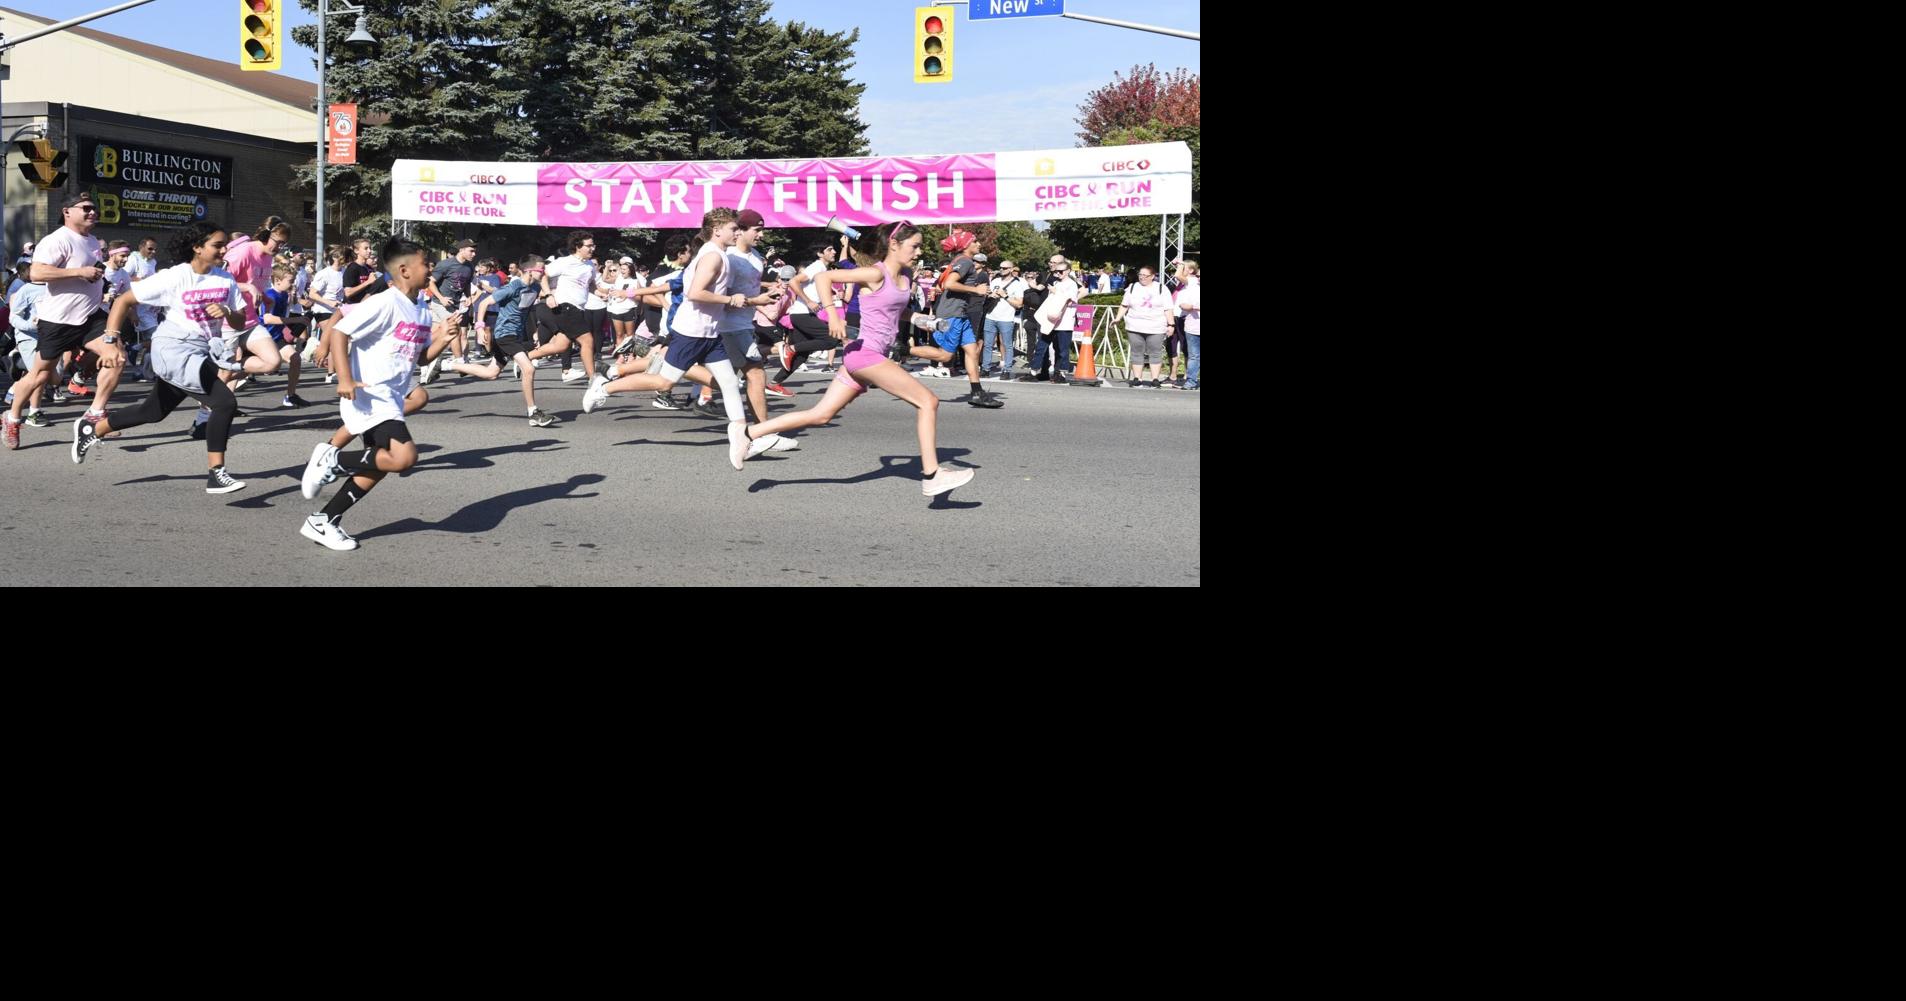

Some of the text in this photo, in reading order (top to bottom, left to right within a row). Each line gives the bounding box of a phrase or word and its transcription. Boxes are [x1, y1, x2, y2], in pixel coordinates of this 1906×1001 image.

[990, 0, 1028, 15] New
[122, 149, 222, 174] BURLINGTON
[1102, 160, 1135, 172] CIBC
[122, 167, 221, 191] CURLING CLUB
[470, 174, 494, 184] CIBC
[122, 189, 198, 204] COME THROW
[564, 176, 722, 214] START
[774, 170, 964, 213] FINISH
[1035, 180, 1151, 199] CIBC RUN
[420, 191, 507, 205] CIBC RUN
[1035, 201, 1067, 213] FOR
[1108, 196, 1152, 209] CURE
[123, 201, 146, 209] ROCKS
[173, 205, 193, 213] HOUSE
[419, 205, 506, 217] FOR THE CURE
[128, 210, 160, 219] Interested
[167, 213, 192, 222] curling?
